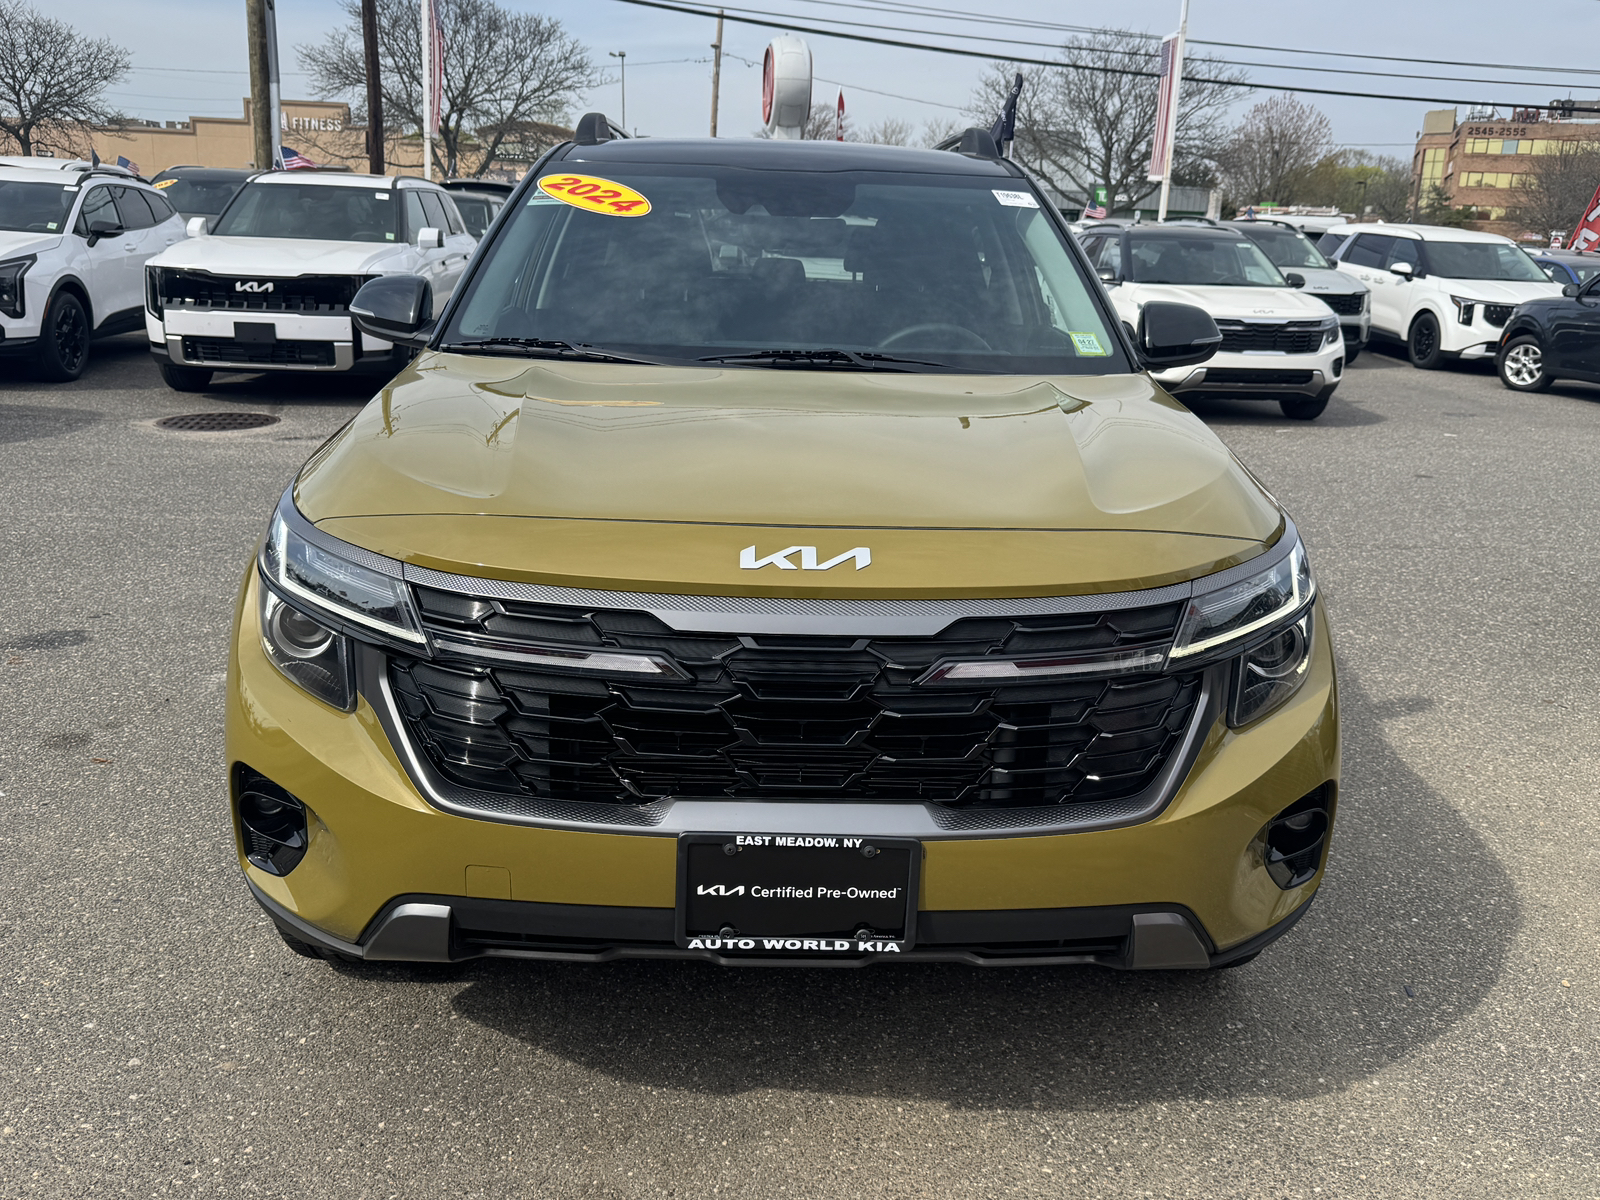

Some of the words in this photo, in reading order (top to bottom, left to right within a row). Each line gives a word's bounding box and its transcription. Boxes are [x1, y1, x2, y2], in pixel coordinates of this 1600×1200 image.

[293, 117, 342, 131] FITNESS
[1467, 126, 1526, 136] 2545-2555
[543, 177, 645, 212] 2024
[739, 545, 872, 571] KIA
[736, 835, 771, 846] EAST
[843, 838, 863, 848] NY
[697, 884, 745, 896] KIA
[751, 886, 813, 898] Certified
[688, 939, 755, 949] AUTO
[763, 940, 850, 950] WORLD
[858, 941, 901, 952] KIA
